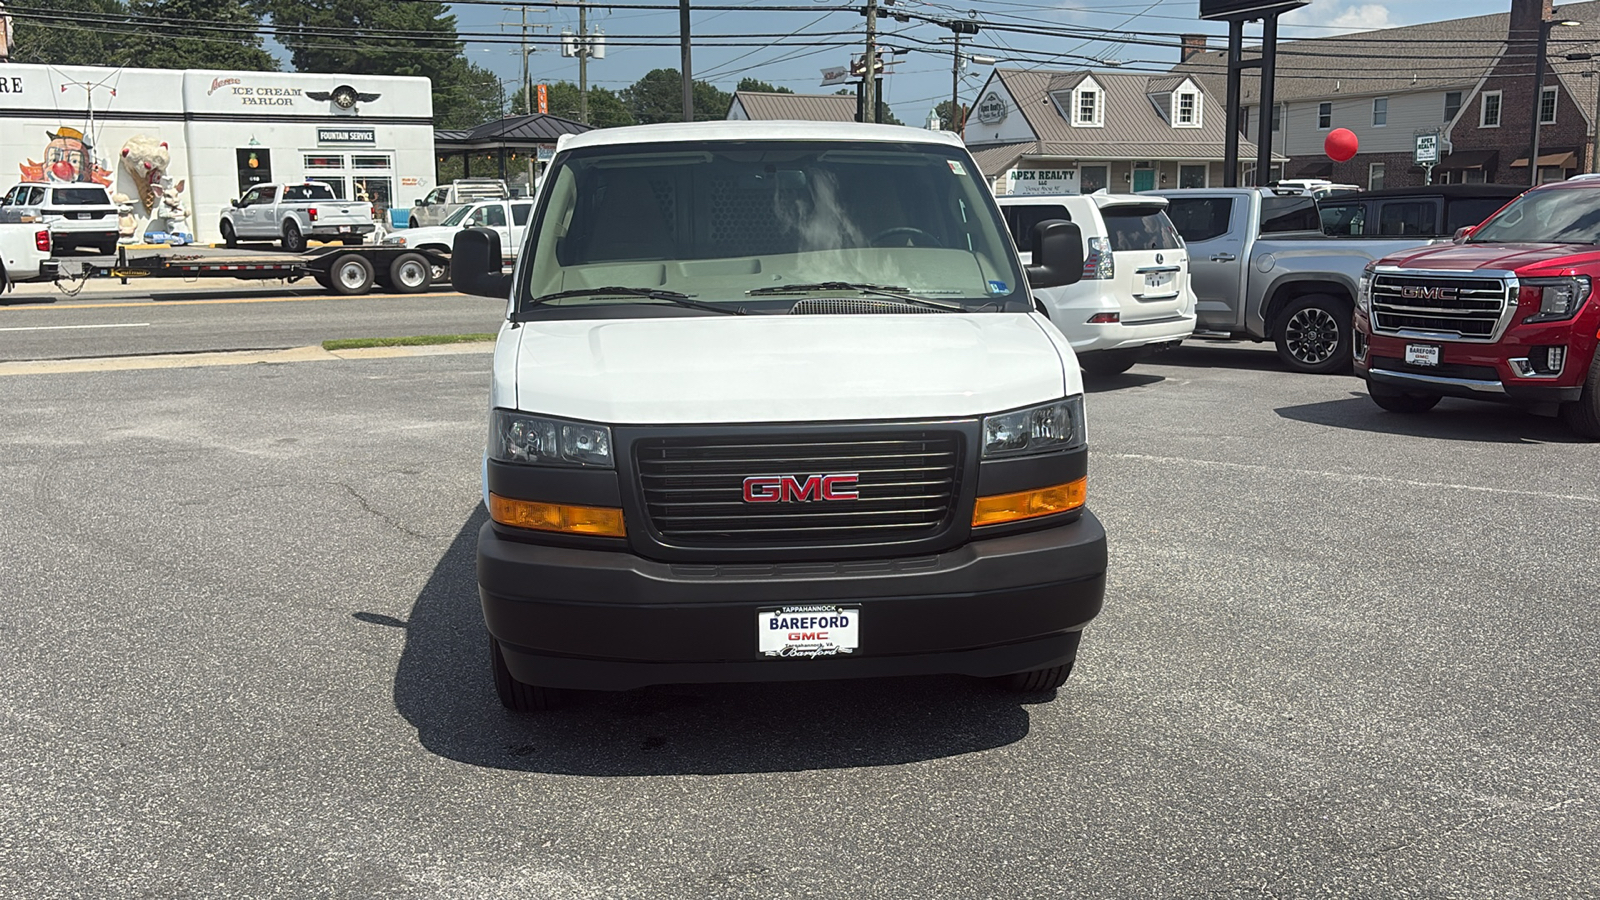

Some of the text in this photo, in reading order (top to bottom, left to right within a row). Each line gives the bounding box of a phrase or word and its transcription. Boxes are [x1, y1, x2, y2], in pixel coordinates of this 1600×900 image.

[232, 87, 302, 96] ICE CREAM
[242, 97, 293, 106] PARLOR
[320, 131, 373, 140] FOUNTAIN SERVICE
[1011, 171, 1075, 180] APEX REALTY
[1402, 286, 1458, 300] GMC
[1410, 347, 1437, 355] BAREFORD
[743, 474, 859, 503] GMC
[770, 616, 849, 630] BAREFORD
[788, 632, 829, 641] GMC
[780, 645, 840, 660] Bareford
